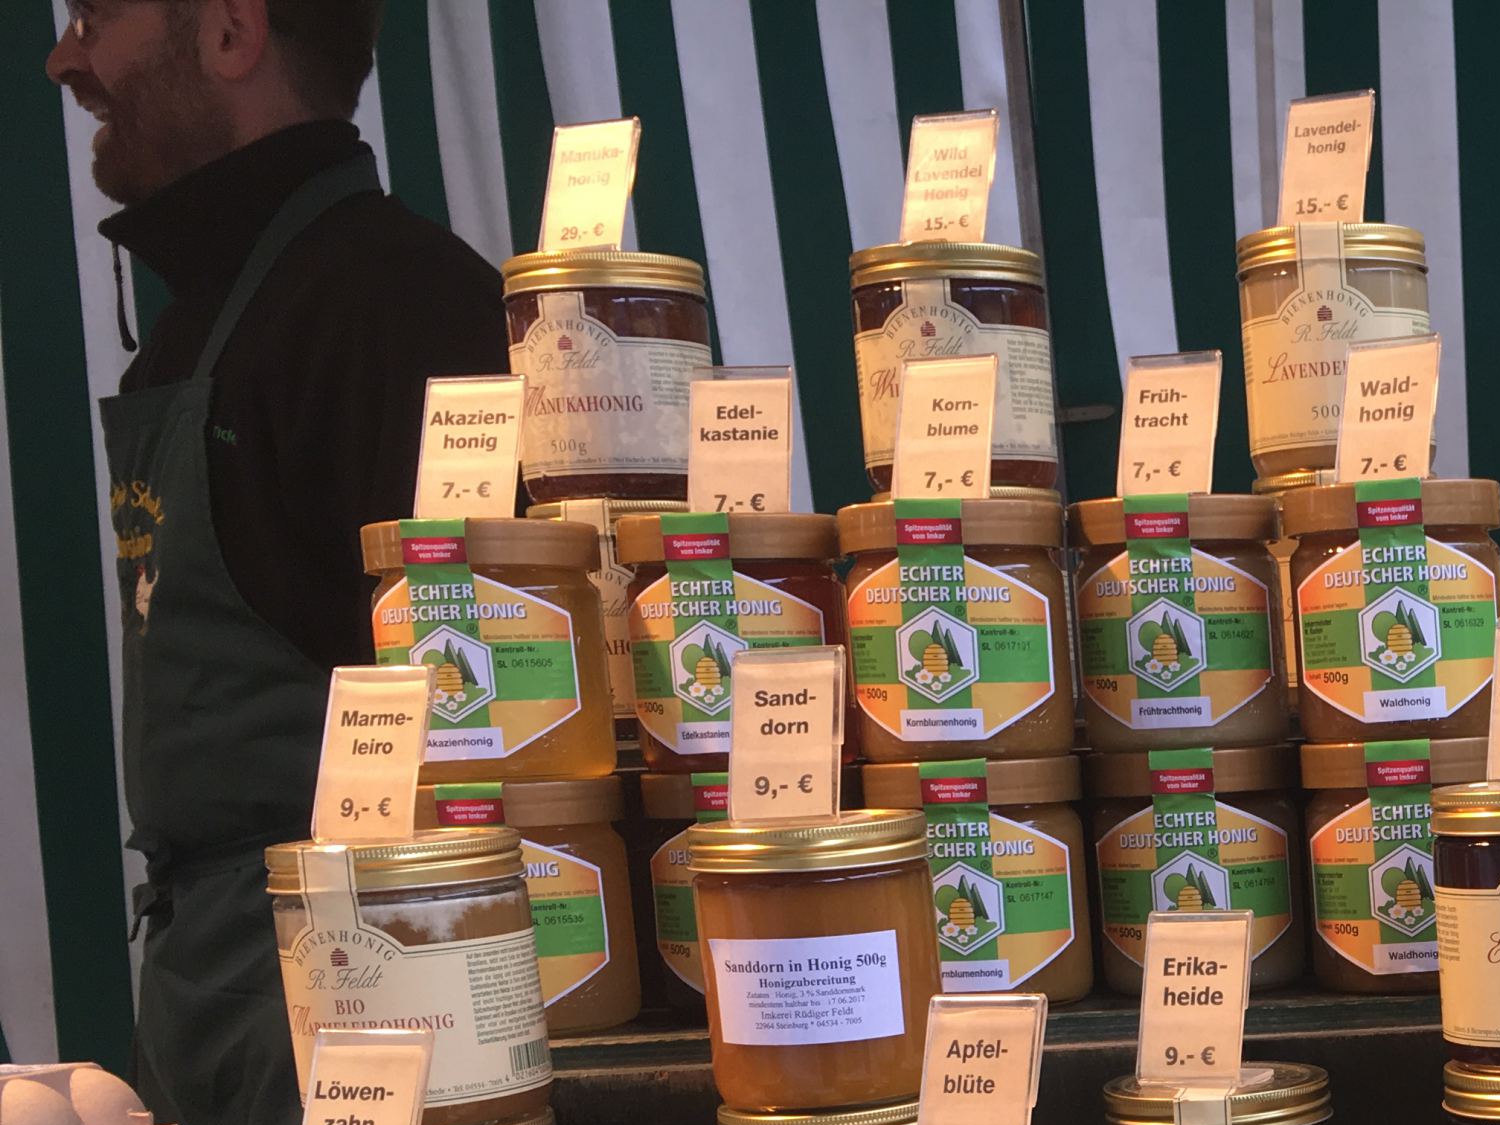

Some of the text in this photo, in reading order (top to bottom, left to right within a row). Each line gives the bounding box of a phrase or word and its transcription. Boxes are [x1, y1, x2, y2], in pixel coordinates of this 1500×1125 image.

[1294, 120, 1361, 138] Lavendel-
[934, 148, 967, 161] Wild
[1307, 140, 1346, 154] honig
[914, 165, 983, 182] Lavendel
[924, 185, 968, 201] Honig
[1296, 194, 1349, 215] 15.- €
[593, 222, 604, 236] €
[959, 214, 969, 228] €
[1360, 377, 1418, 397] Wald-
[932, 398, 978, 411] Korn-
[1139, 389, 1187, 404] Früh-
[430, 410, 515, 426] Akazien-
[716, 405, 762, 420] Edel-
[1134, 413, 1189, 428] tracht
[1359, 403, 1414, 423] honig
[700, 426, 779, 442] kastanie
[927, 422, 979, 437] blume
[443, 433, 497, 452] honig
[1133, 460, 1181, 480] 7,- €
[1360, 455, 1407, 475] 7.- €
[924, 470, 974, 490] 7,- €
[441, 481, 491, 499] 7.- €
[751, 493, 765, 511] €
[1362, 546, 1426, 564] ECHTER
[1324, 564, 1467, 588] DEUTSCHER HONIG
[754, 689, 816, 706] Sand-
[1380, 696, 1431, 708] Waldhonig
[341, 710, 412, 728] Marme-
[760, 718, 809, 736] dorn
[906, 717, 977, 728] Kornblumenhonig
[352, 740, 393, 755] leiro
[754, 774, 813, 797] 9,- €
[340, 798, 391, 821] 9,- €
[725, 952, 887, 974] Sanddorn in Honig 500g
[1163, 957, 1228, 977] Erika-
[759, 973, 856, 989] Honigzubereitung
[1163, 987, 1223, 1005] heide
[946, 1039, 1009, 1061] Apfel-
[1165, 1046, 1216, 1066] 9.- €
[314, 1080, 394, 1101] Löwen-
[943, 1073, 995, 1094] blüte
